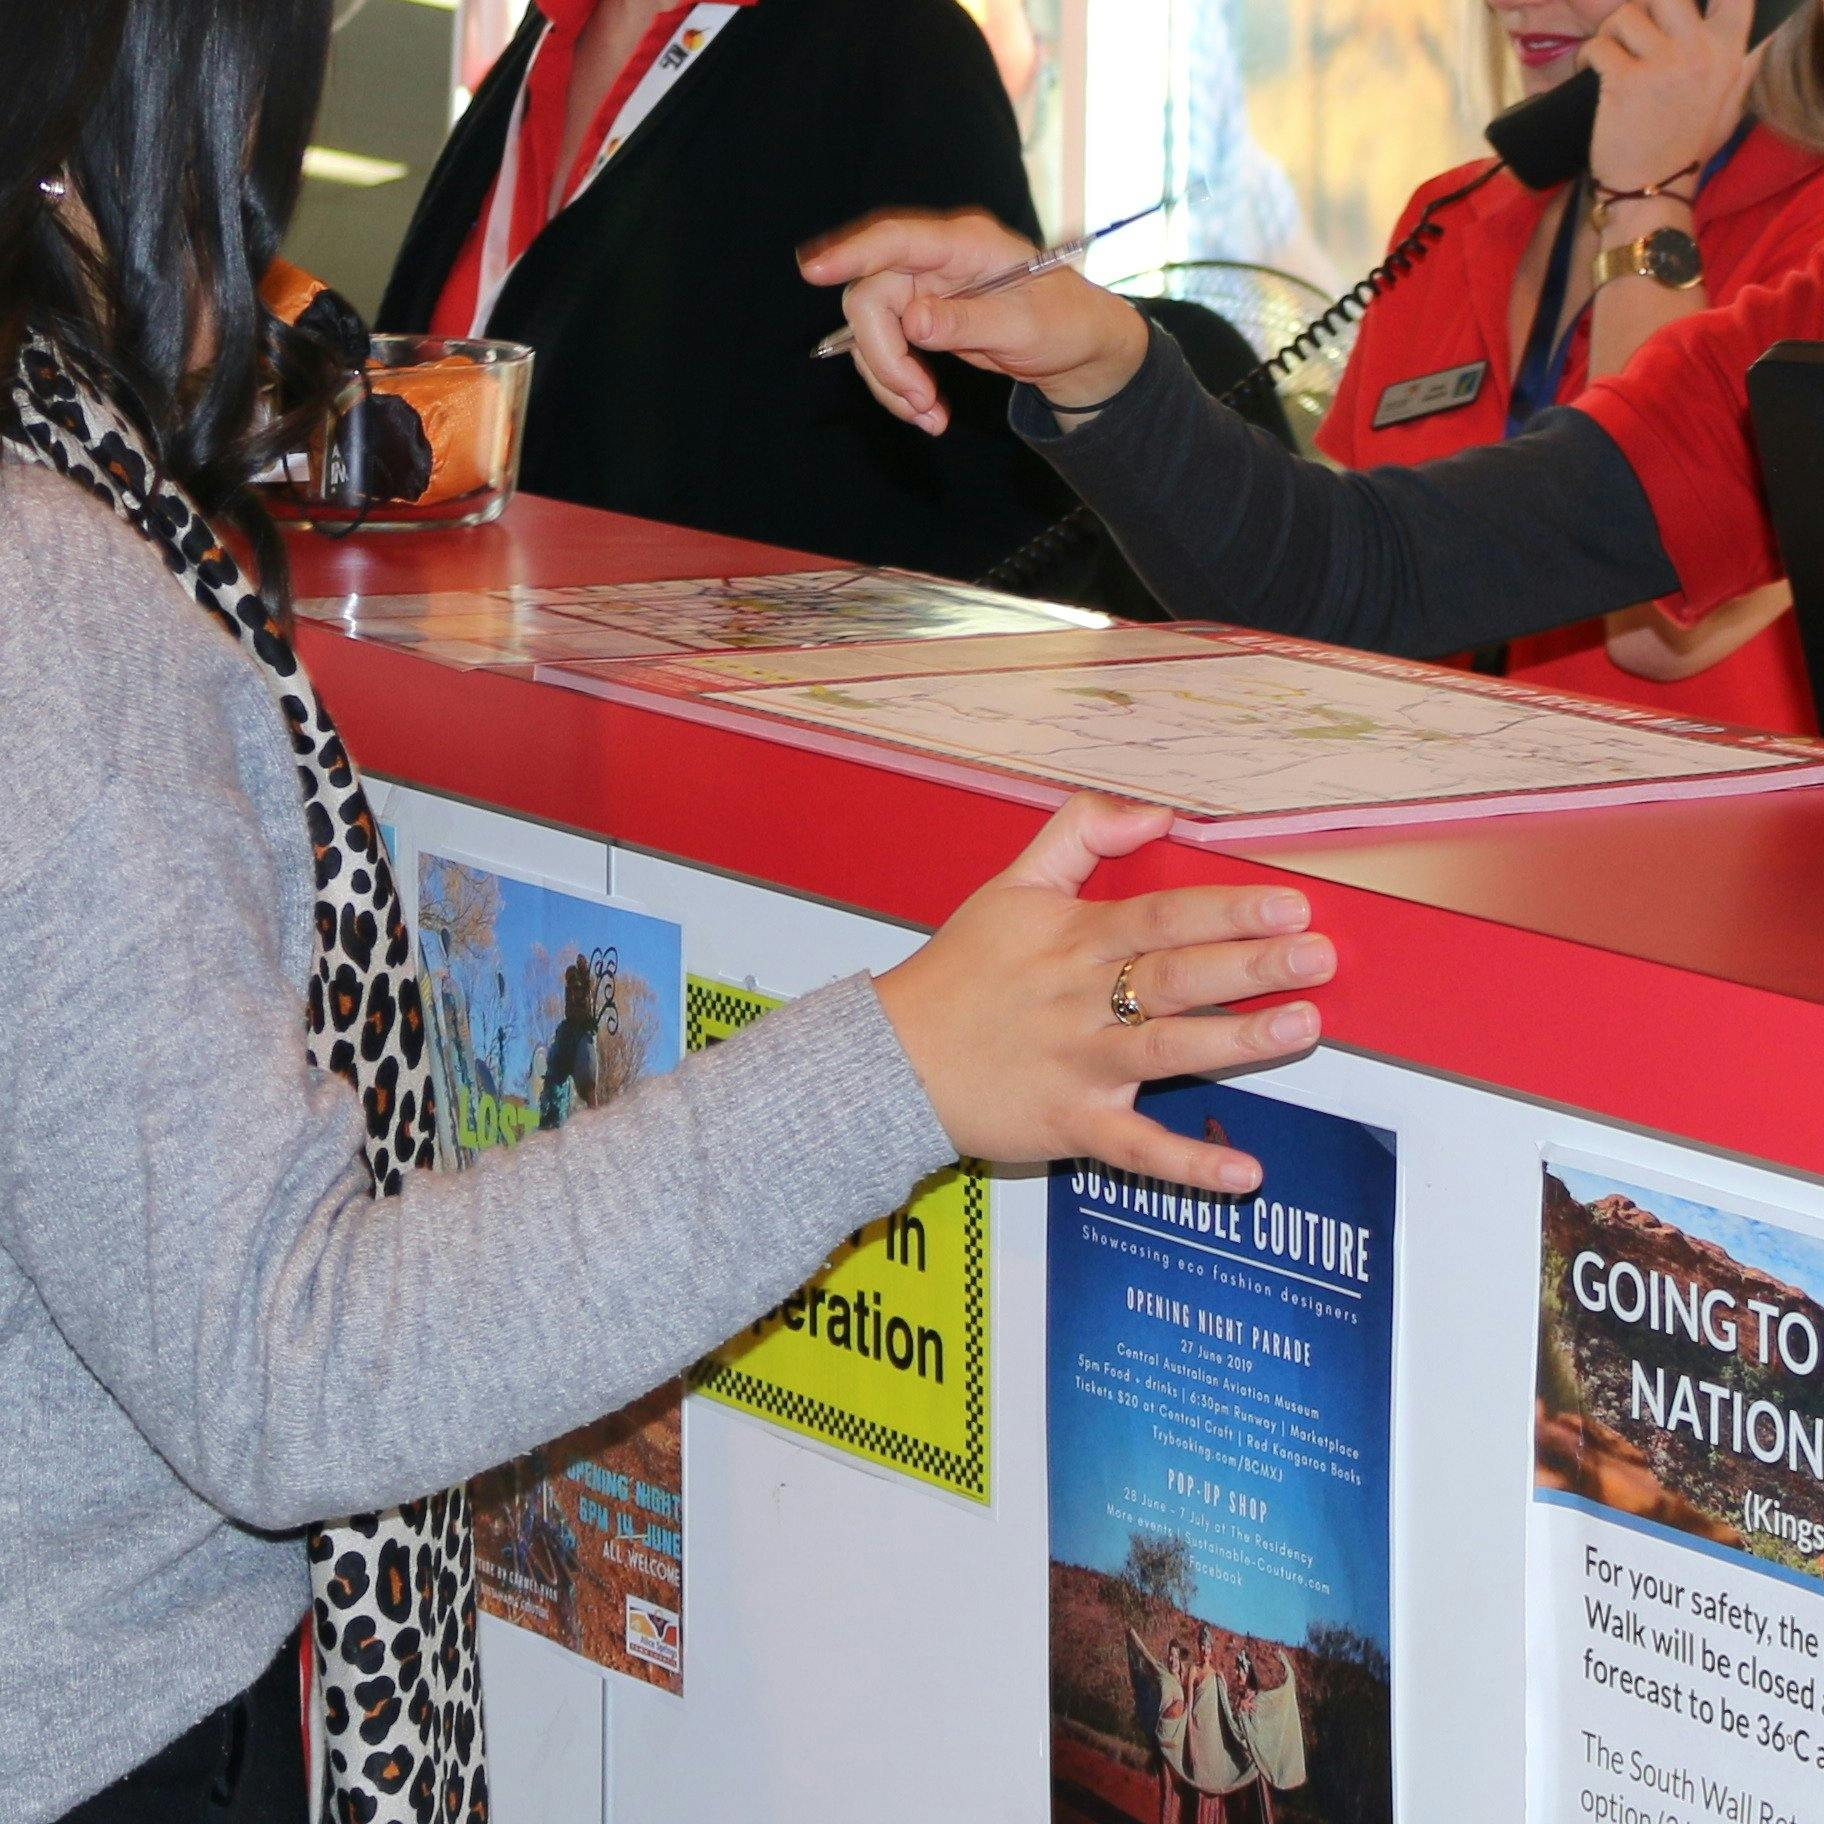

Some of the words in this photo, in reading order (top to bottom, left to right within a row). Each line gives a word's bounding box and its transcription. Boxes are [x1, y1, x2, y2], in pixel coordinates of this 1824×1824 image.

[1082, 1225, 1170, 1269] Showcasing
[1178, 1257, 1204, 1277] eco
[1212, 1264, 1272, 1296] fashion
[1280, 1286, 1360, 1325] designers
[1252, 1197, 1370, 1283] COUTURE
[753, 1285, 944, 1384] eration
[1127, 1286, 1190, 1328] OPENING
[1198, 1309, 1243, 1345] NIGHT
[1252, 1326, 1311, 1367] PARADE
[1180, 1338, 1194, 1354] 27
[1198, 1345, 1222, 1364] June
[1227, 1354, 1253, 1373] 2019
[1572, 1250, 1738, 1352] GOING
[1747, 1298, 1819, 1375] TO
[1077, 1354, 1100, 1372] 5pm
[1103, 1362, 1130, 1382] Food
[1145, 1376, 1178, 1398] drinks
[1190, 1391, 1230, 1416] 6:30pm
[1233, 1405, 1277, 1434] Runway
[1290, 1424, 1360, 1460] Marketplace
[1116, 1342, 1159, 1366] Central
[1163, 1358, 1219, 1387] Australian
[1223, 1378, 1270, 1404] Aviation
[1274, 1395, 1320, 1419] Museum
[1075, 1375, 1113, 1400] Tickets
[1117, 1389, 1139, 1408] $20
[1142, 1401, 1155, 1414] at
[1158, 1404, 1201, 1429] Central
[1204, 1420, 1234, 1441] Craft
[1246, 1433, 1268, 1452] Red
[1273, 1443, 1327, 1472] Kangaroo
[1331, 1462, 1362, 1486] Books
[1153, 1425, 1283, 1483] Trybooking.com/BCMXJ
[636, 1480, 682, 1522] NIGHT
[1141, 1494, 1166, 1512] June
[1190, 1511, 1209, 1532] July
[1214, 1523, 1227, 1535] at
[1231, 1526, 1250, 1543] The
[1255, 1534, 1314, 1569] Residency
[1168, 1468, 1221, 1507] POP-UP
[1229, 1490, 1267, 1523] SHOP
[603, 1539, 623, 1563] ALL
[628, 1549, 681, 1586] WELCOME
[643, 1522, 682, 1561] JUNE
[1107, 1503, 1133, 1523] More
[1137, 1517, 1173, 1538] events
[1184, 1531, 1330, 1595] Sustainable-Couture.com
[1189, 1555, 1243, 1587] Facebook
[1585, 1544, 1623, 1586] For
[1628, 1568, 1685, 1609] your
[1691, 1592, 1772, 1645] safety,
[1778, 1616, 1819, 1658] the
[1583, 1648, 1682, 1714] forecast
[1689, 1689, 1714, 1724] to
[1721, 1696, 1750, 1738] be
[1584, 1595, 1645, 1648] Walk
[1652, 1627, 1694, 1665] will
[1702, 1638, 1731, 1678] be
[1737, 1656, 1814, 1711] closed
[1581, 1729, 1624, 1775] The
[1629, 1749, 1695, 1804] South
[1701, 1776, 1752, 1824] Wall
